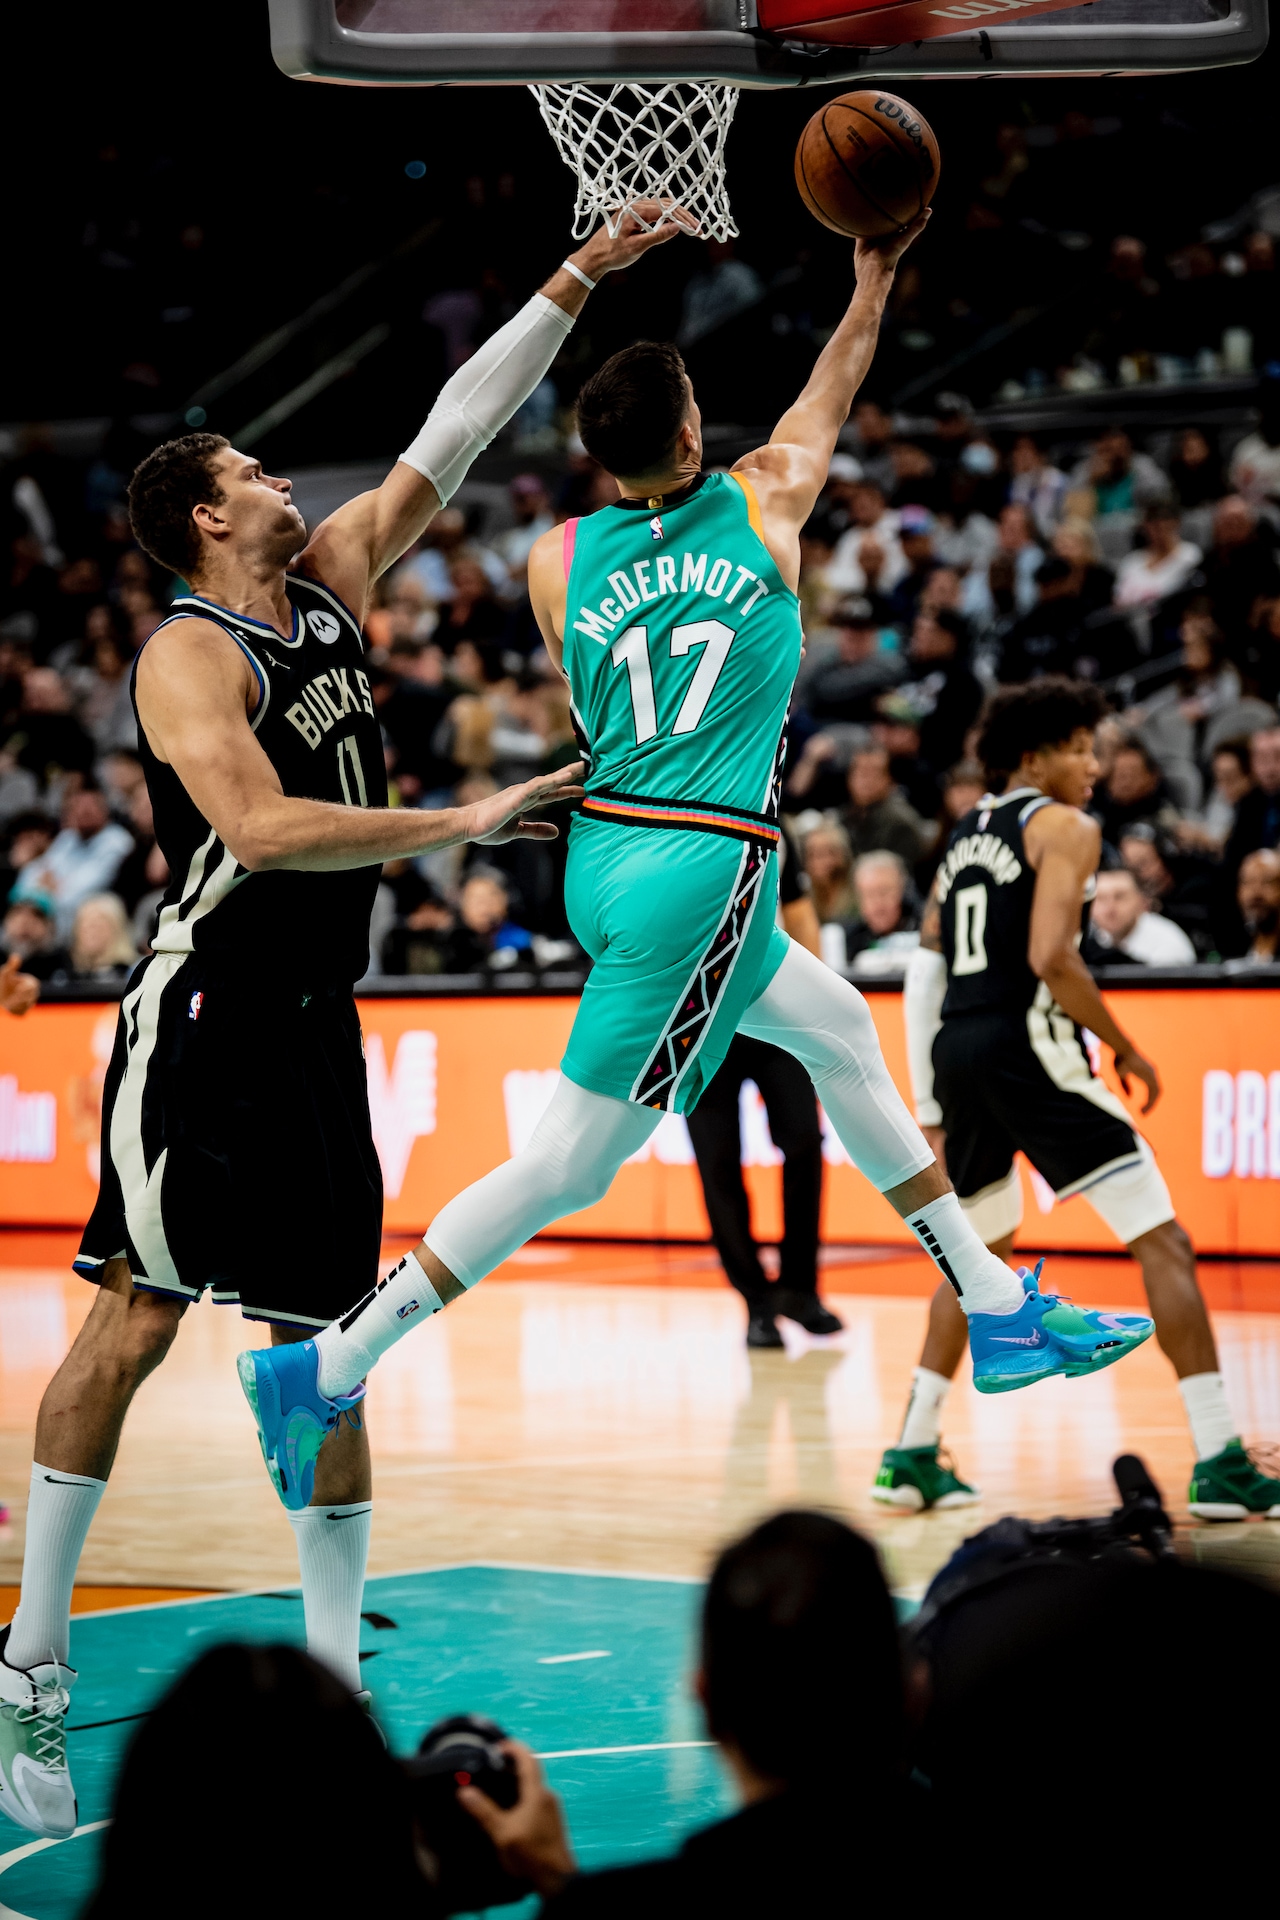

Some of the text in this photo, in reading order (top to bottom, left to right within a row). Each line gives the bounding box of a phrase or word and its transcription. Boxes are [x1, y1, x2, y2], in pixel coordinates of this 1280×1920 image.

[573, 552, 769, 646] McDERMOTT
[284, 667, 375, 750] BUCKS
[610, 618, 737, 749] 17
[336, 734, 369, 807] 11
[952, 883, 988, 976] 0
